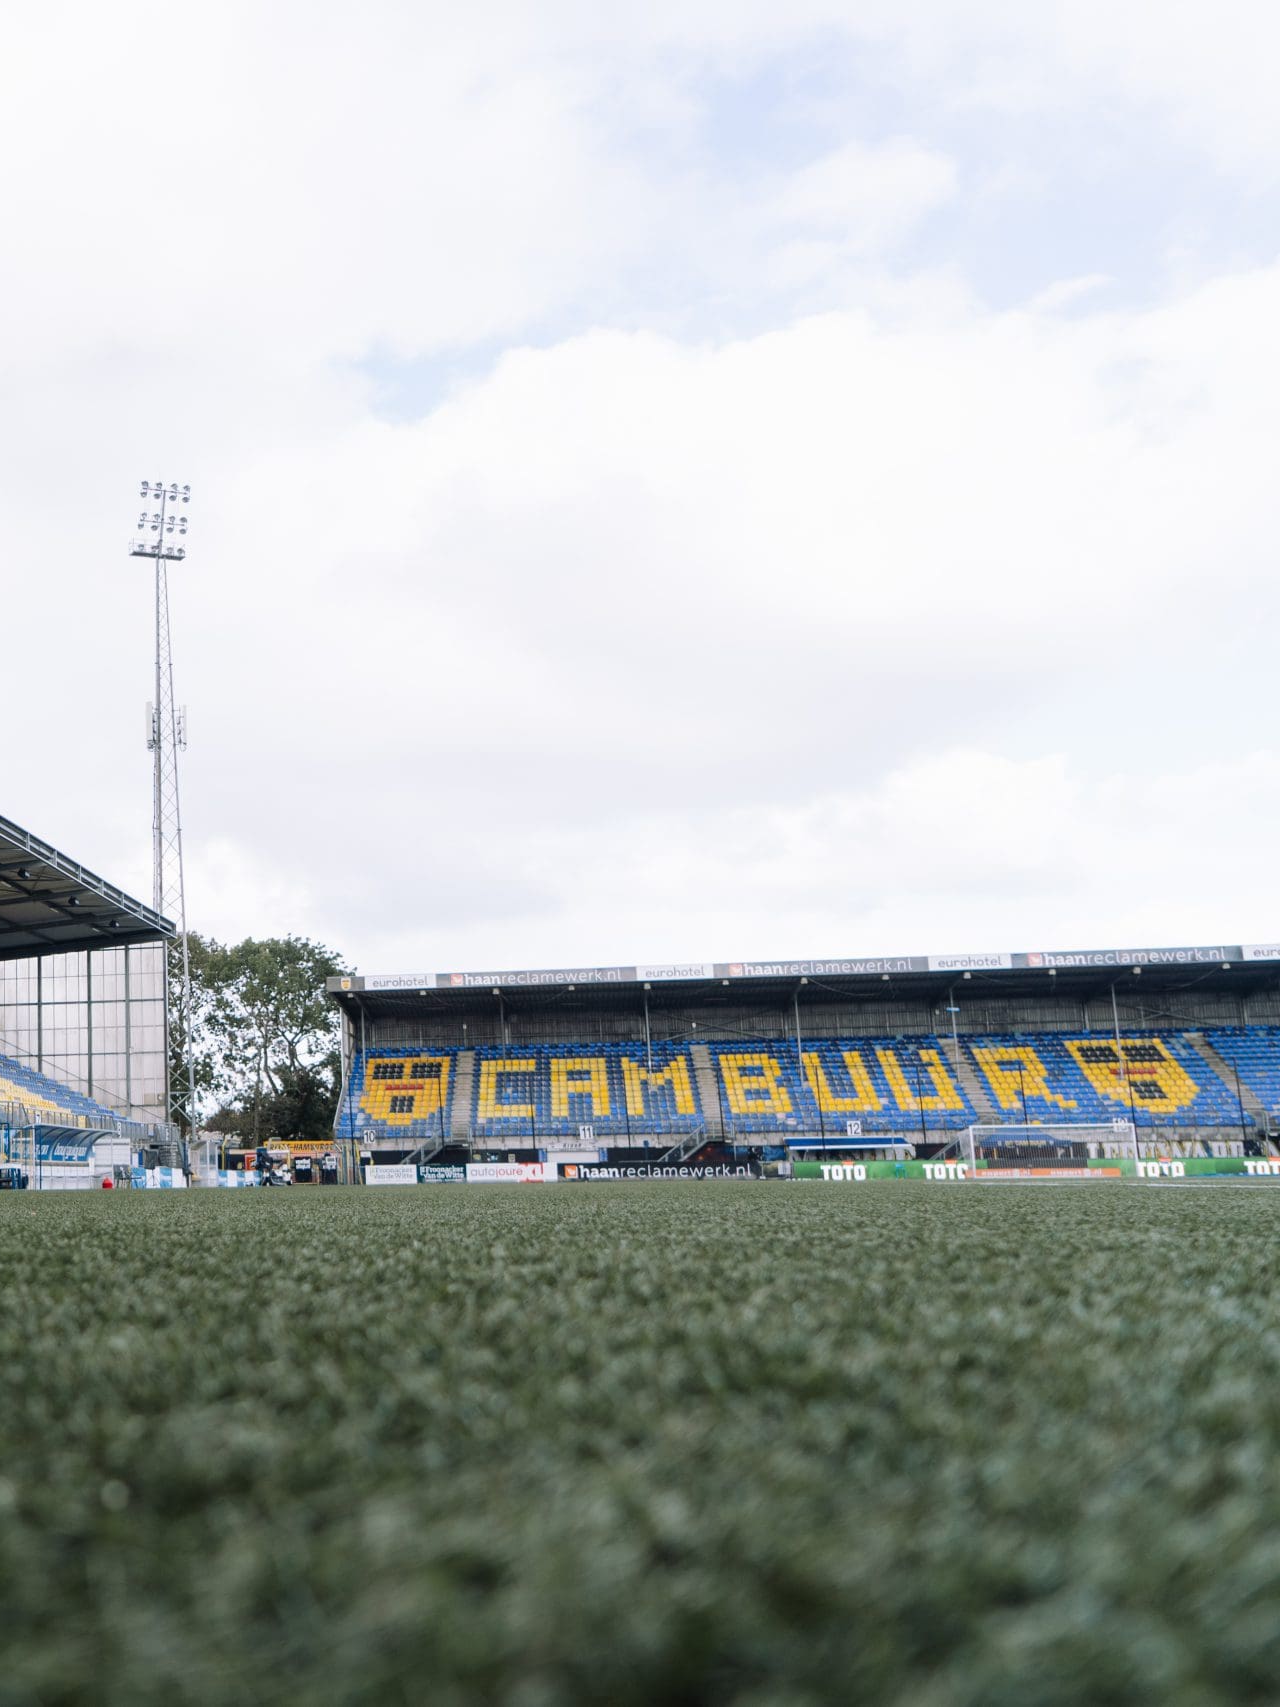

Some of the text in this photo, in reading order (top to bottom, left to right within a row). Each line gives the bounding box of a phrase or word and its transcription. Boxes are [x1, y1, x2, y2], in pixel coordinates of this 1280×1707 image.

[937, 956, 1003, 968] eurohotel
[1043, 946, 1226, 965] haanreclamewerk.nl
[645, 965, 705, 978] eurohotel
[744, 957, 913, 975] haanreclamewerk.nl
[372, 975, 429, 988] eurohotel
[464, 967, 621, 986] haanreclamewerk.nl
[477, 1048, 1077, 1117] CAMBUUR
[581, 1125, 592, 1138] 11
[848, 1122, 860, 1135] 12
[364, 1130, 375, 1143] 10
[470, 1168, 523, 1178] autojoure
[580, 1163, 753, 1178] haanreclamewerk.nl
[821, 1164, 866, 1181] TOTO
[1137, 1161, 1185, 1177] TOTO
